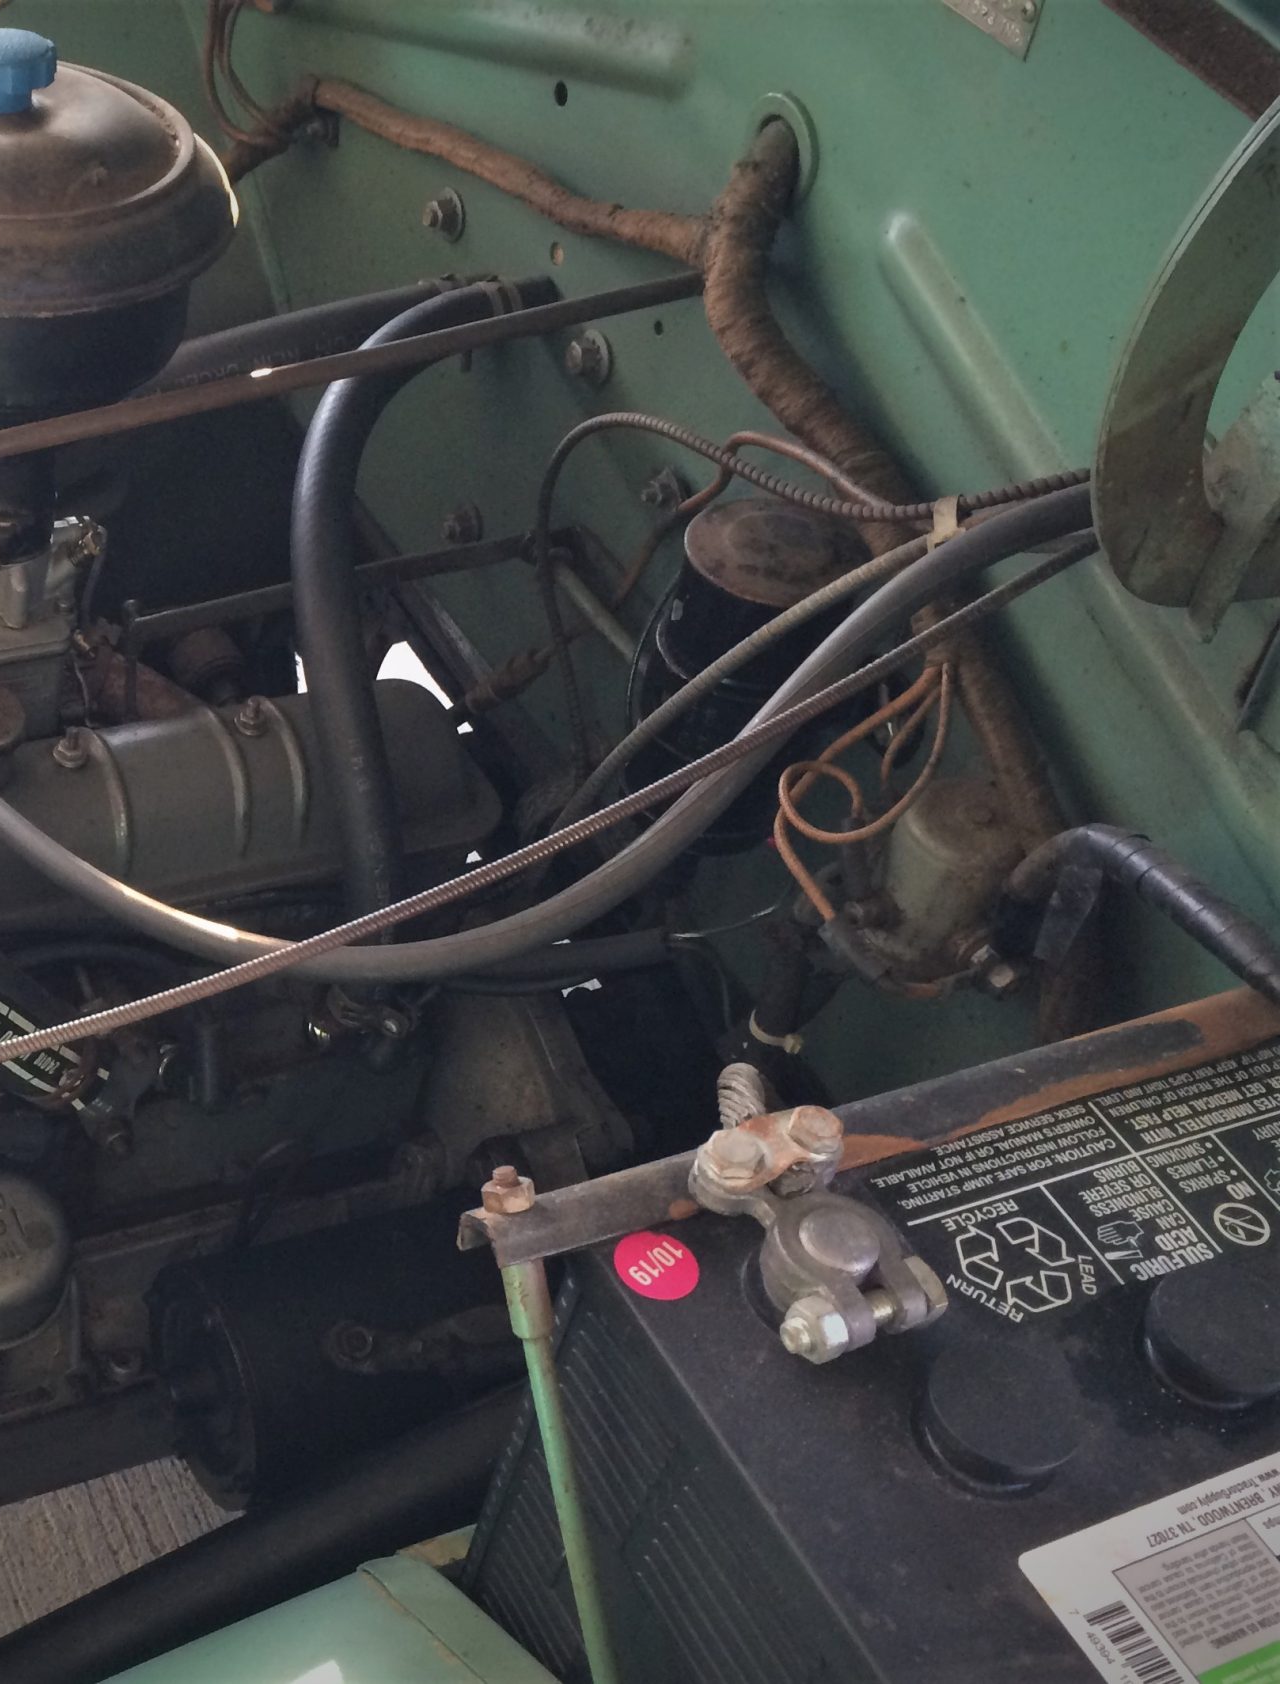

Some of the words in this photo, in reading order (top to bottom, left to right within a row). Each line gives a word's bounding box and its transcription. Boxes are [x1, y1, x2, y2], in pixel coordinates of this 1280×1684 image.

[1230, 1069, 1249, 1082] OF
[1248, 1063, 1270, 1077] OUT
[1176, 1080, 1213, 1099] REACH
[1212, 1075, 1231, 1089] THE
[1241, 1081, 1266, 1098] GET
[1107, 1094, 1161, 1118] CHILDREN
[1160, 1090, 1177, 1104] OF
[1188, 1088, 1244, 1112] MEDICAL
[1053, 1104, 1087, 1121] SEEK
[1124, 1111, 1161, 1131] FAST.
[1159, 1102, 1193, 1120] HELP
[1173, 1101, 1256, 1135] IMMEDIATELY
[1005, 1112, 1053, 1135] SERVICE
[1041, 1115, 1097, 1139] OWNER'S
[1139, 1125, 1176, 1145] WITH
[929, 1124, 1006, 1156] ASSISTANCE.
[993, 1130, 1041, 1154] MANUAL
[1058, 1126, 1106, 1148] FOLLOW
[939, 1154, 966, 1171] NOT
[965, 1151, 977, 1163] IF
[971, 1141, 1058, 1173] INSTRUCTIONS
[976, 1145, 994, 1159] OR
[1050, 1138, 1117, 1164] CAUTION:
[1144, 1141, 1207, 1168] SMOKING
[869, 1160, 940, 1189] AVAILABLE,
[958, 1168, 971, 1180] IN
[995, 1164, 1025, 1181] SAFE
[1025, 1156, 1050, 1173] FOR
[1092, 1160, 1140, 1183] BURNS
[1165, 1154, 1218, 1180] FLAMES
[906, 1172, 959, 1193] VEHICLE
[962, 1173, 994, 1192] JUMP
[1077, 1177, 1132, 1204] SEVERE
[1131, 1172, 1152, 1188] OR
[1177, 1168, 1232, 1194] SPARKS
[1225, 1180, 1256, 1200] NO
[896, 1184, 961, 1210] STARTING,
[1088, 1185, 1164, 1218] BLINDNESS
[940, 1198, 1019, 1232] RECYCLE
[1128, 1198, 1175, 1221] CAUSE
[1154, 1211, 1187, 1230] CAN
[1154, 1225, 1199, 1251] ACID
[628, 1241, 683, 1286] 10/19
[1129, 1242, 1214, 1281] SULFURIC
[1077, 1254, 1097, 1296] LEAD
[945, 1273, 1024, 1323] RETURN
[1145, 1526, 1179, 1548] 37027
